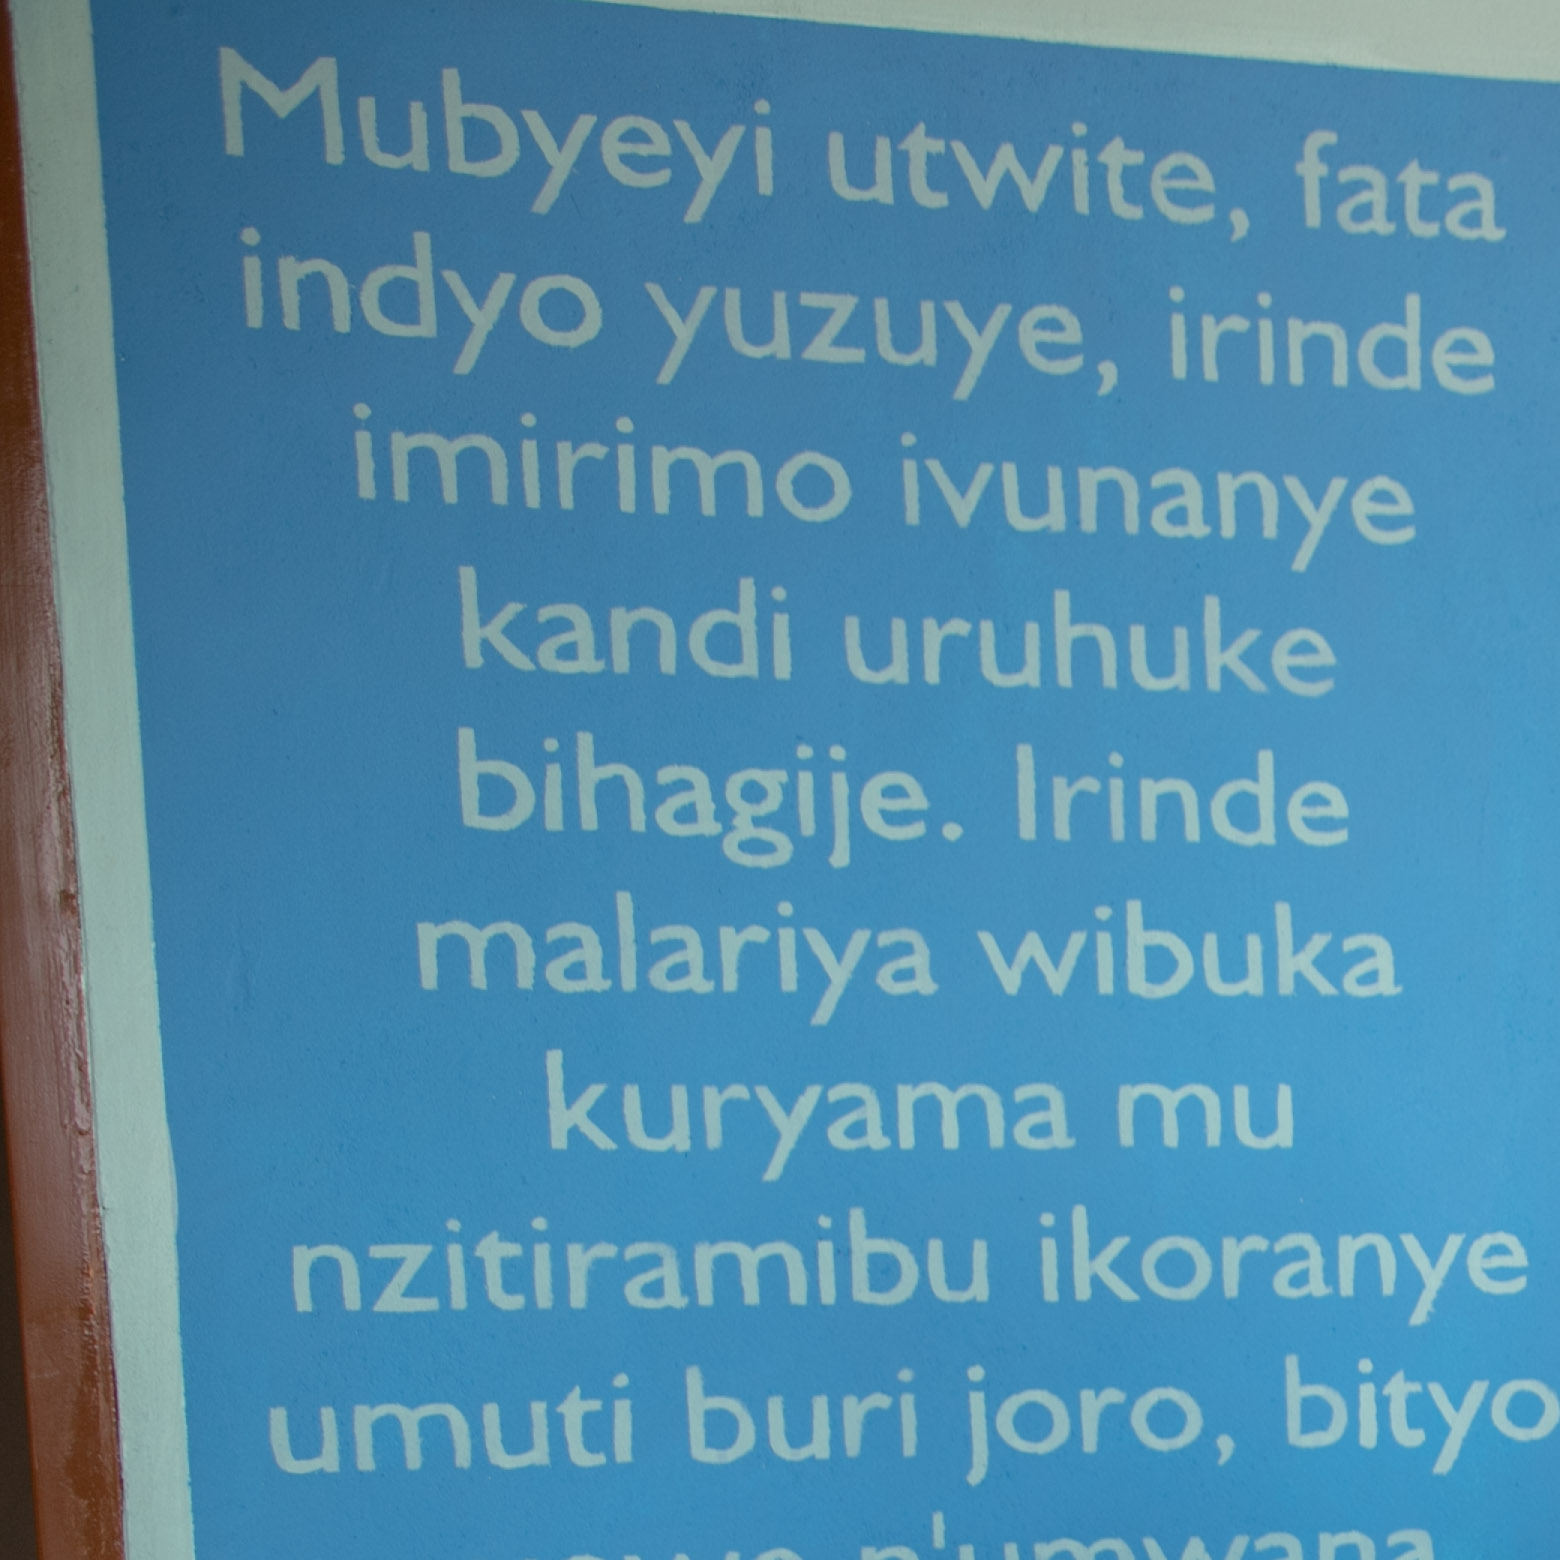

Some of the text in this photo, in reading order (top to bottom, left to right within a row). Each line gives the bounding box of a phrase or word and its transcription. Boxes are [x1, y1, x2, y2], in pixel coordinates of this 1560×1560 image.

[219, 46, 1507, 242] Mubyeyi utwite, fata
[240, 226, 1495, 401] indyo yuzuye, irinde
[352, 402, 1416, 573] imirimo ivunanye
[458, 565, 1337, 698] kandi uruhuke
[457, 726, 1350, 869] bihagije. Irinde
[416, 890, 1403, 1026] malariya wibuka
[545, 1048, 1294, 1182] kuryama mu
[291, 1204, 1529, 1327] nzitiramibu ikoranye
[268, 1353, 1560, 1487] umuti buri joro, bityo
